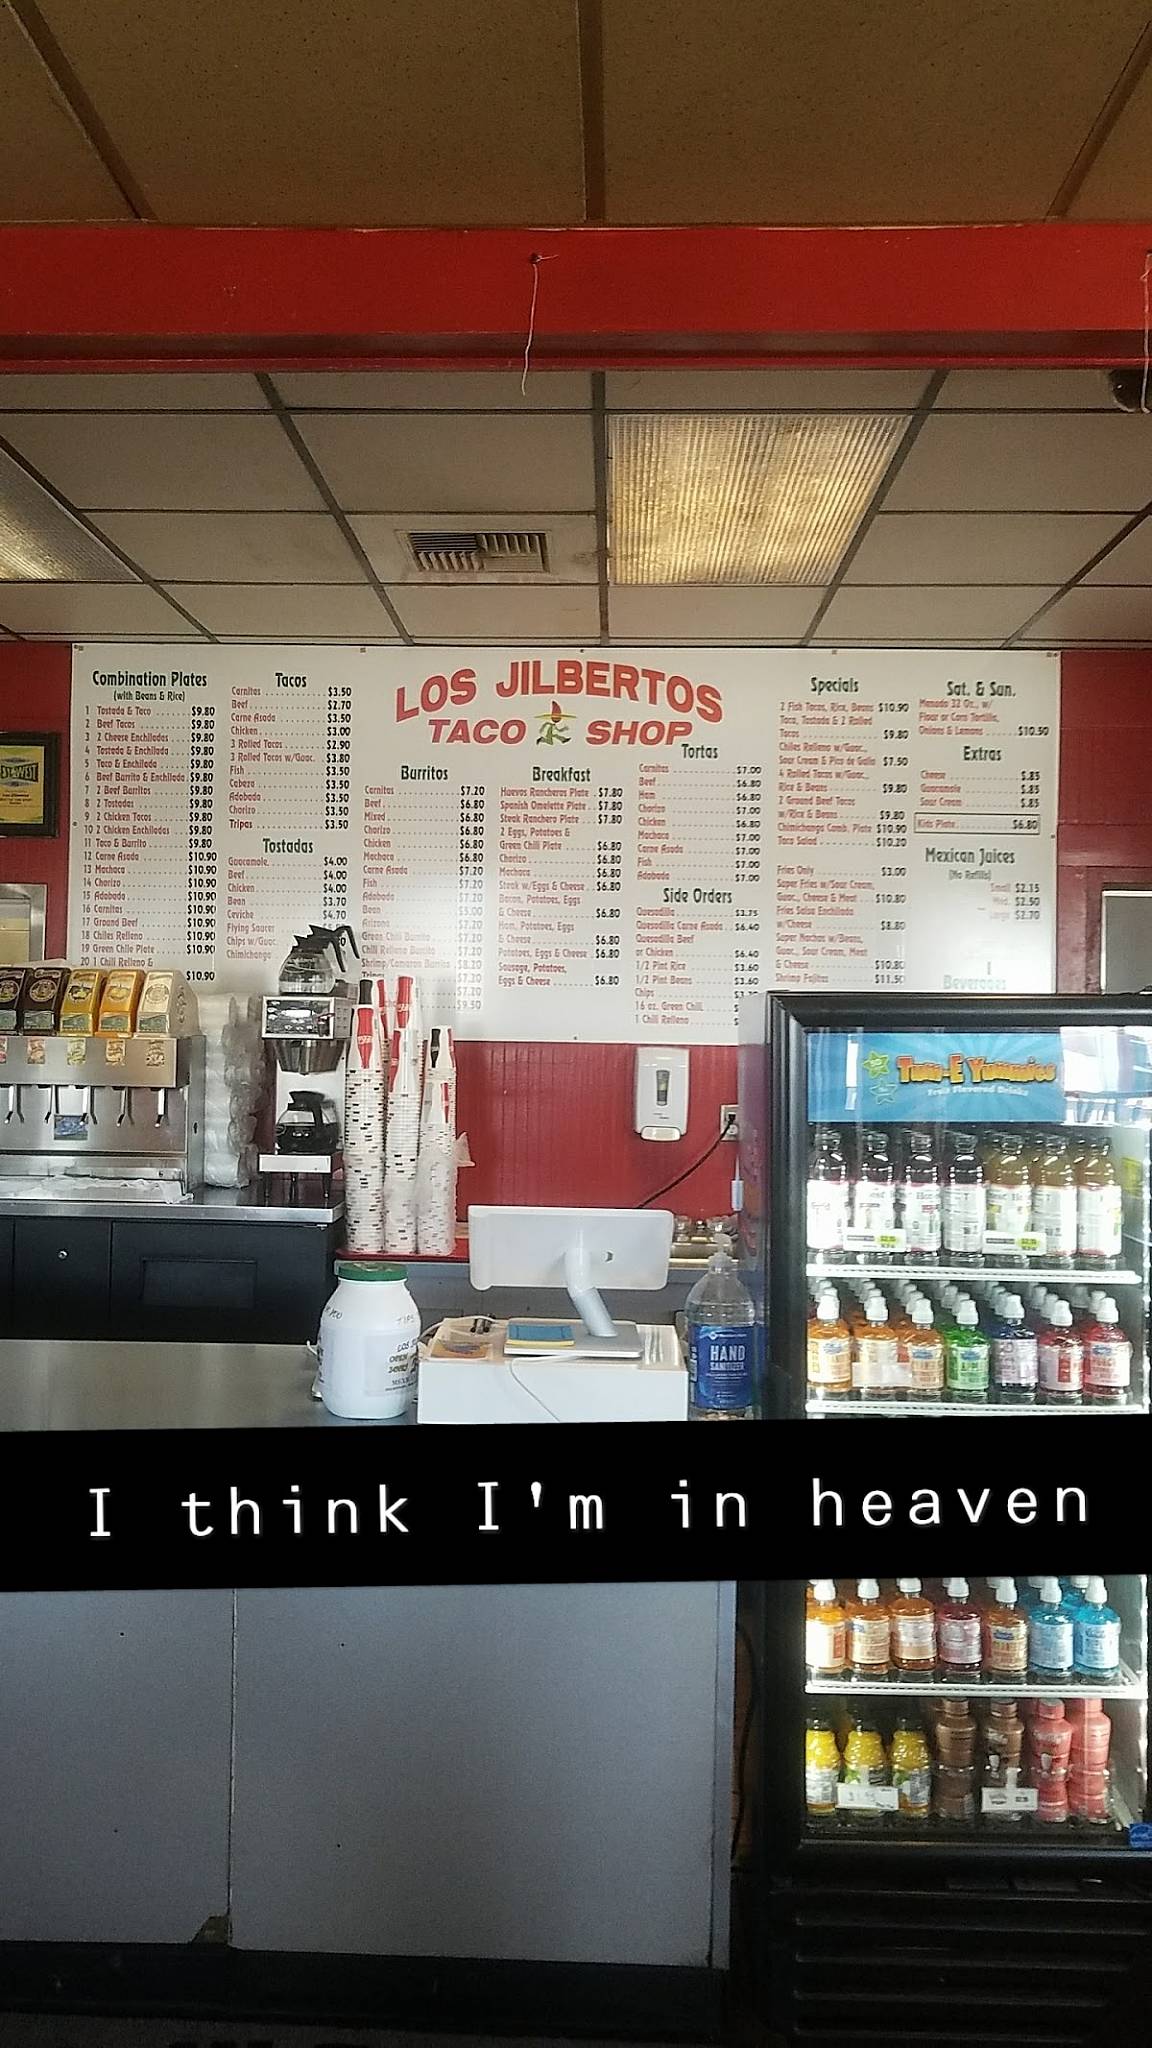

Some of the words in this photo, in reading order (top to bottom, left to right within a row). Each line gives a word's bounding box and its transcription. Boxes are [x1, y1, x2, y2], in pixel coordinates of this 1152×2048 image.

[93, 671, 166, 686] Combination
[171, 672, 207, 686] Plates
[275, 673, 306, 687] Tacos
[232, 686, 260, 695] Carnitas
[328, 687, 351, 697] $3.50
[811, 677, 858, 695] Specials
[947, 681, 970, 696] Sat.
[976, 682, 984, 696] &
[990, 682, 1016, 696] Sun.
[114, 690, 133, 701] (with
[136, 691, 157, 700] Beans
[167, 691, 185, 702] Rice)
[396, 669, 476, 723] LOS
[495, 660, 722, 724] JILBERTOS
[232, 700, 248, 709] Beef
[328, 700, 351, 710] $2.70
[97, 706, 124, 715] Tostada
[127, 706, 133, 715] &
[135, 706, 151, 715] Taco
[192, 706, 215, 716] $9.80
[231, 713, 251, 722] Carne
[254, 713, 275, 723] Asada
[328, 713, 351, 723] $3.50
[97, 719, 113, 728] Beef
[117, 719, 135, 728] Tacos
[192, 719, 214, 729] $9.80
[231, 726, 258, 735] Chicken
[327, 727, 351, 736] $3.00
[428, 719, 526, 744] TACO
[586, 720, 692, 746] SHOP
[946, 726, 953, 735] &
[104, 732, 128, 742] Cheese
[131, 733, 168, 742] Enchiladas
[191, 733, 214, 742] $9.80
[238, 739, 261, 749] Rolled
[264, 739, 282, 748] Tacos
[327, 740, 350, 750] $2.90
[97, 746, 124, 755] Tostada
[126, 746, 132, 755] &
[134, 746, 168, 755] Enchilada
[191, 746, 214, 756] $9.80
[681, 744, 718, 758] Tortas
[964, 746, 1001, 761] Extras
[96, 759, 112, 768] Taco
[123, 759, 157, 768] Enchilada
[191, 759, 214, 769] $9.80
[230, 765, 244, 775] Fish
[326, 766, 350, 776] $3.50
[401, 766, 448, 780] Burritos
[533, 767, 590, 782] Breakfast
[97, 772, 113, 781] Beef
[115, 772, 140, 781] Burrito
[190, 772, 213, 782] $9.80
[365, 785, 394, 794] Carnitas
[461, 786, 485, 796] $7.20
[530, 787, 567, 797] Rancheros
[569, 788, 589, 797] Plate
[599, 788, 623, 797] $7.80
[778, 782, 795, 792] Rice
[796, 782, 803, 791] &
[805, 783, 828, 792] Beans
[883, 784, 907, 793] $9.80
[364, 812, 385, 821] Mixed
[460, 812, 484, 822] $6.80
[500, 814, 521, 823] Steak
[523, 814, 557, 823] Ranchero
[560, 814, 579, 823] Plate
[598, 814, 622, 824] $7.80
[638, 817, 666, 826] Chicken
[736, 820, 760, 828] $6.80
[84, 825, 93, 834] 10
[103, 825, 130, 834] Chicken
[132, 825, 169, 834] Enchiladas
[189, 825, 212, 835] $9.80
[229, 819, 252, 830] Tripas
[325, 819, 348, 829] $3.50
[1012, 820, 1037, 829] $6.80
[263, 838, 313, 853] Tostadas
[364, 839, 391, 847] Chicken
[460, 839, 484, 849] $6.80
[500, 840, 521, 849] Green
[542, 841, 562, 850] Plate
[598, 841, 621, 851] $6.80
[84, 851, 92, 860] 12
[96, 851, 115, 860] Carne
[118, 852, 139, 861] Asada
[189, 851, 217, 861] $10.90
[228, 857, 269, 866] Guacamole
[324, 857, 347, 866] $4.00
[926, 848, 974, 862] Mexican
[979, 848, 1015, 866] Juices
[637, 857, 652, 867] Fish
[84, 864, 91, 873] 13
[95, 864, 125, 874] Machaca
[189, 865, 217, 875] $10.90
[363, 864, 384, 874] Carne
[385, 865, 408, 875] Asada
[460, 866, 483, 876] $7.20
[777, 865, 795, 874] Fries
[797, 865, 814, 876] Only
[882, 867, 906, 876] $3.00
[228, 883, 254, 892] Chicken
[323, 883, 347, 893] $4.00
[664, 888, 688, 903] Side
[693, 888, 732, 903] Orders
[80, 957, 90, 966] 20
[118, 957, 146, 967] Relleno
[147, 958, 153, 967] &
[499, 976, 515, 987] Eggs
[526, 976, 550, 985] Cheese
[595, 976, 619, 985] $6.80
[710, 1345, 745, 1361] HAND
